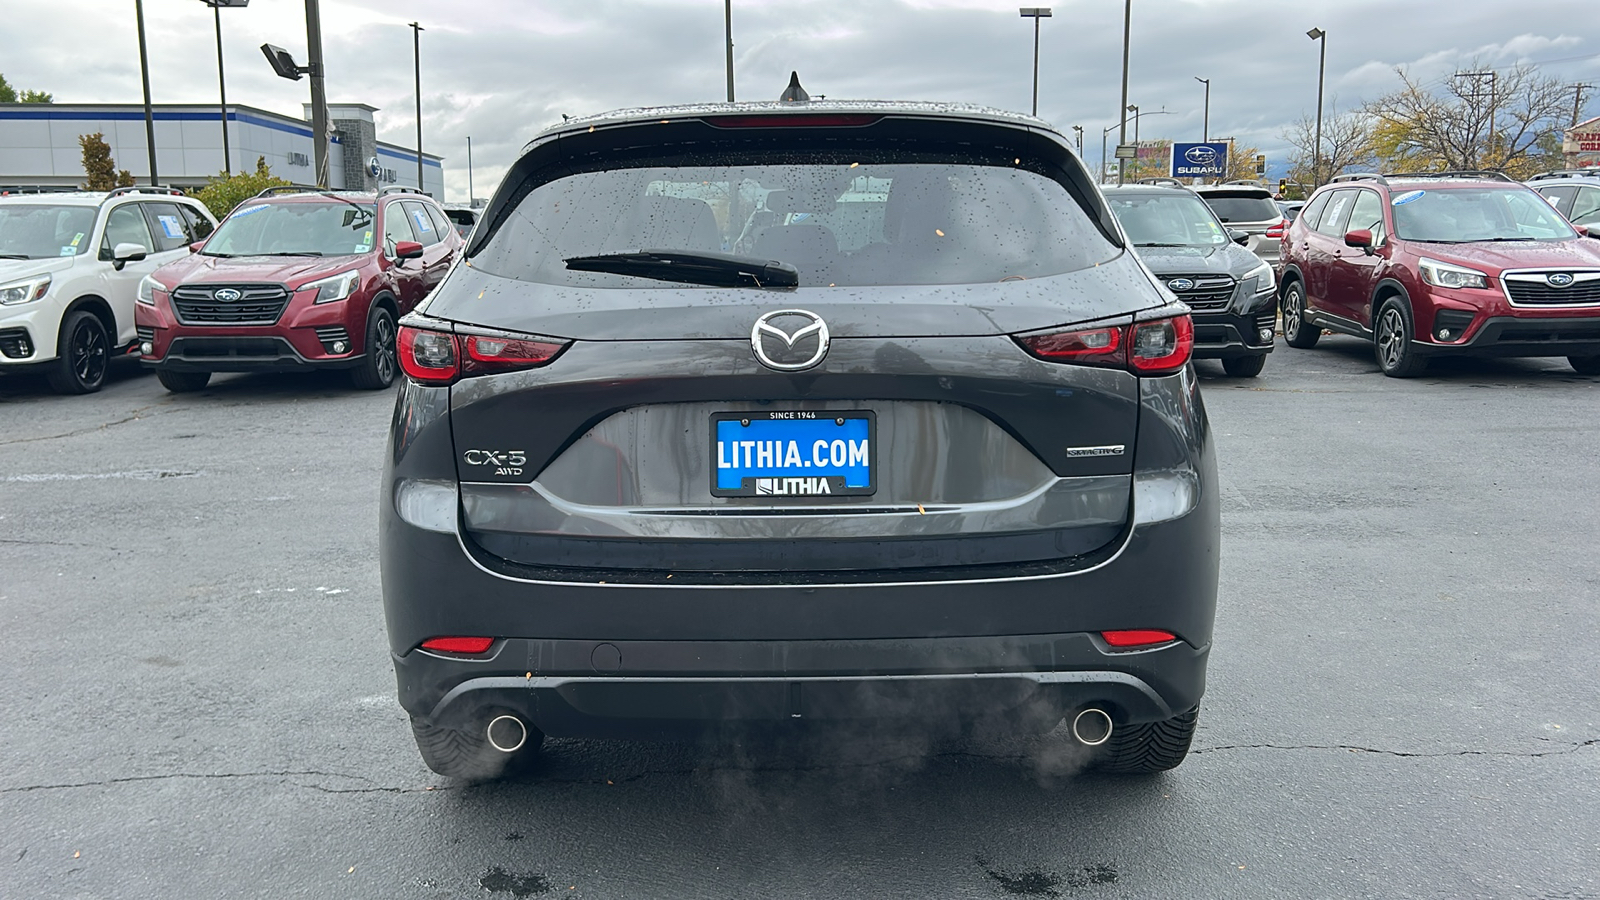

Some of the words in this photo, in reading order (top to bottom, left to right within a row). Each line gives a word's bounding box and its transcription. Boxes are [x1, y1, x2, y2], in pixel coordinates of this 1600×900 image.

[1177, 166, 1223, 174] SUBARU
[769, 412, 795, 420] SINCE
[797, 411, 816, 419] 1946
[463, 449, 527, 466] CX-5
[717, 439, 869, 469] LITHIA.COM
[494, 467, 523, 476] AWD
[773, 477, 832, 495] LITHIA
